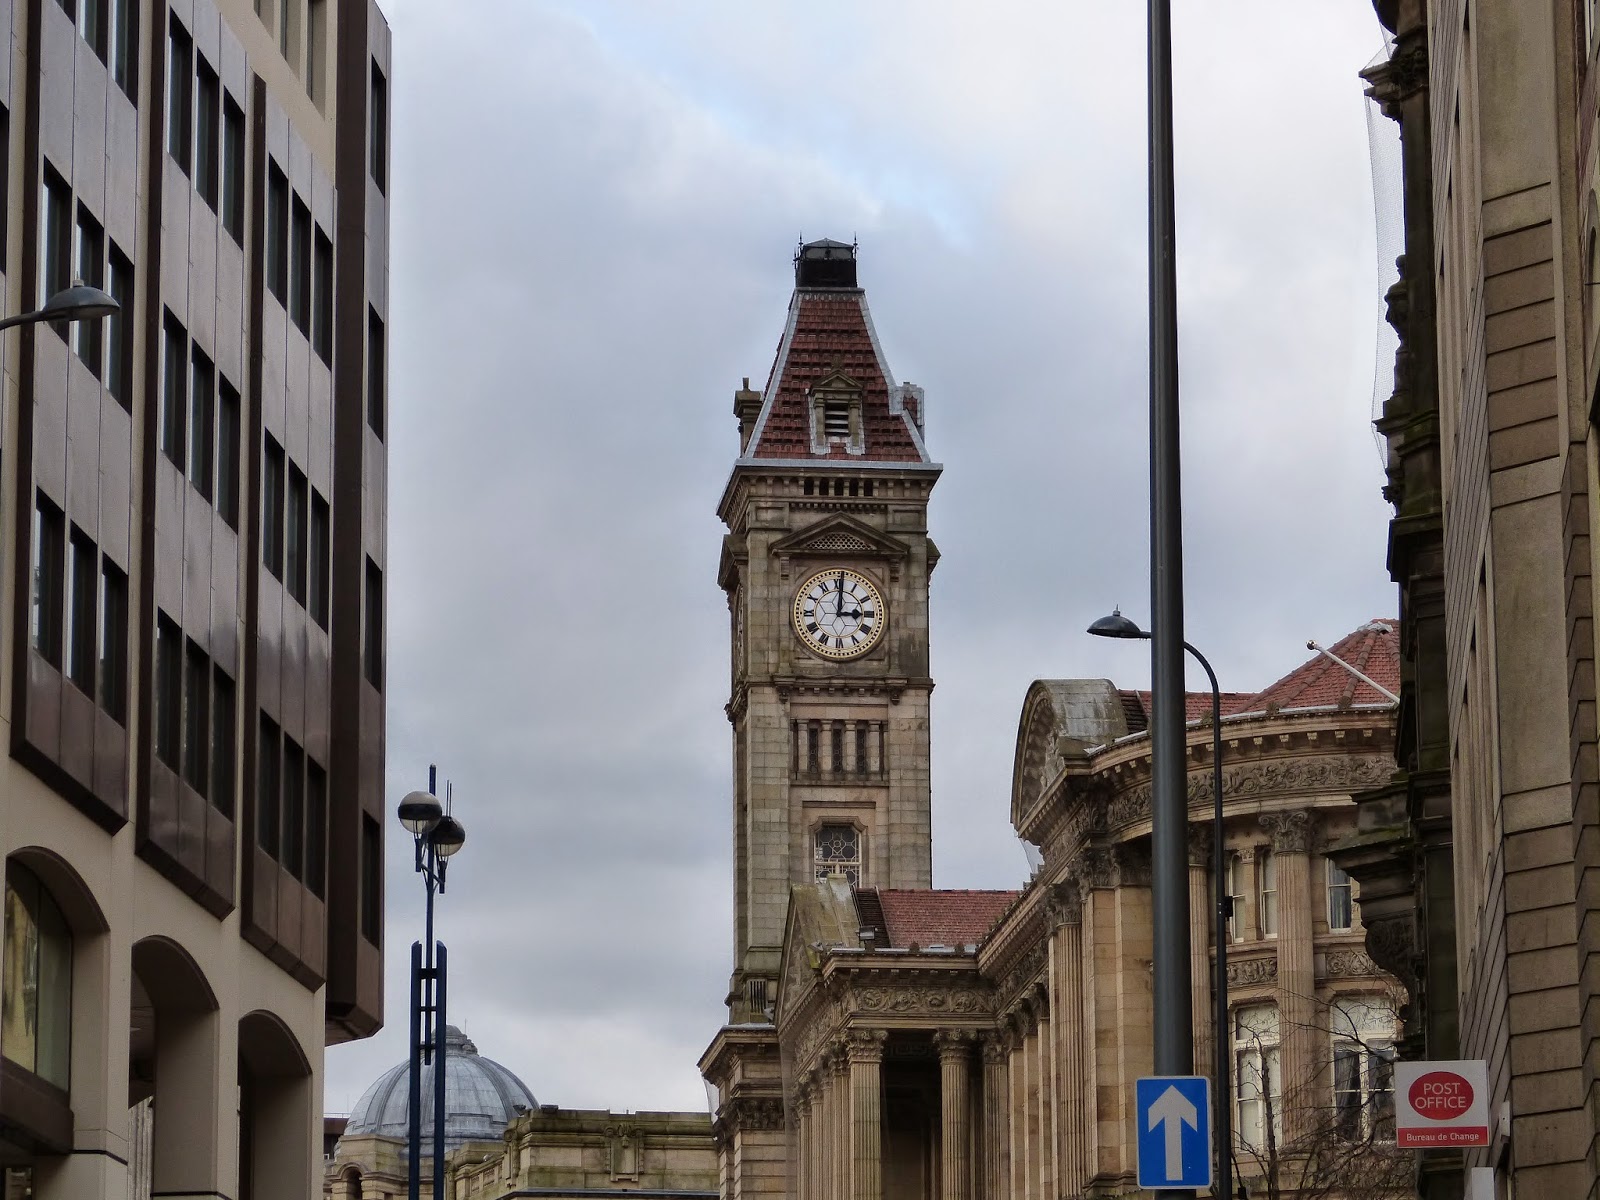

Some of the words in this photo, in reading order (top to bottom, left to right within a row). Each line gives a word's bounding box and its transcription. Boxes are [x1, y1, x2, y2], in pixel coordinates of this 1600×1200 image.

[818, 581, 829, 594] XI
[851, 583, 858, 593] I
[807, 593, 819, 603] X
[1423, 1082, 1460, 1095] POST
[1414, 1096, 1467, 1109] OFFICE
[1406, 1133, 1435, 1141] Bureau
[1450, 1132, 1479, 1142] Change
